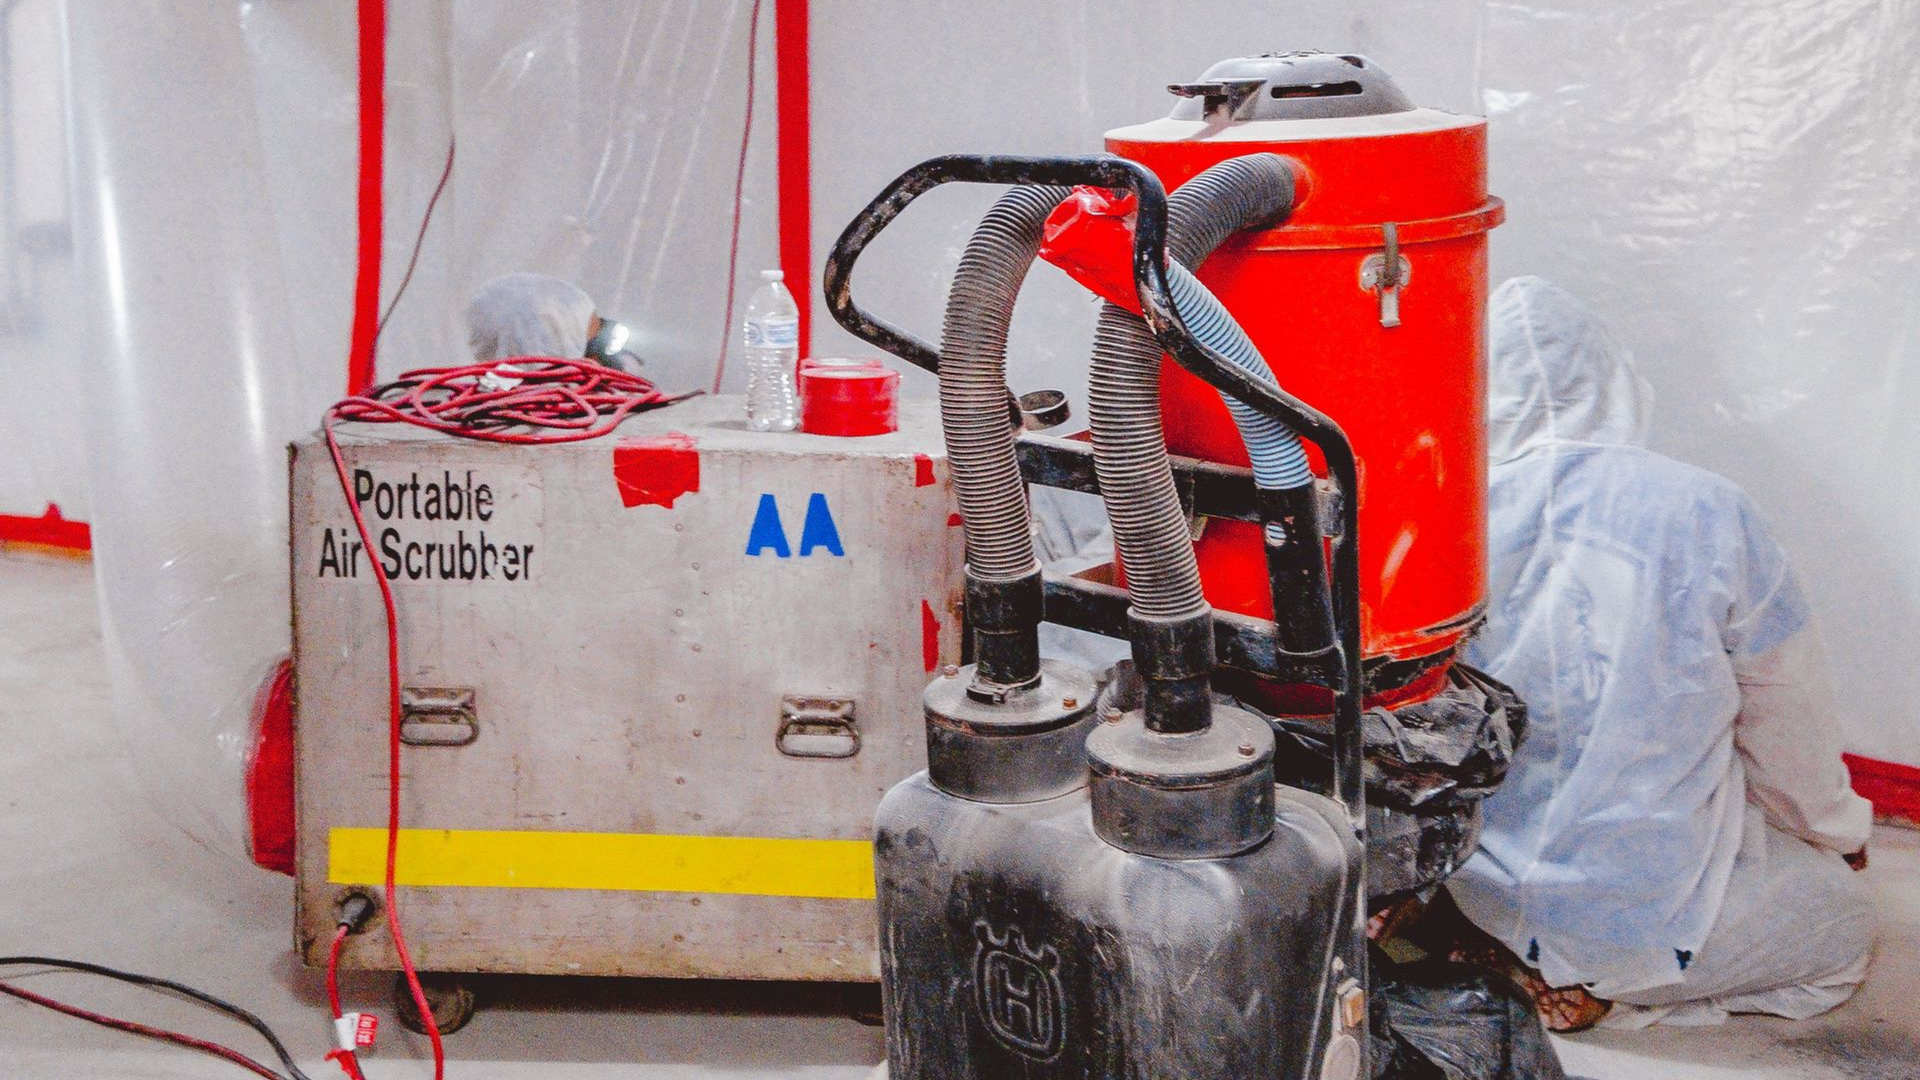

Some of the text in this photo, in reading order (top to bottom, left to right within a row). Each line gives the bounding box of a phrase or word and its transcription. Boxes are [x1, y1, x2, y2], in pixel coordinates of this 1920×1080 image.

[354, 469, 494, 521] Portable
[318, 527, 534, 581] Air Scrubber
